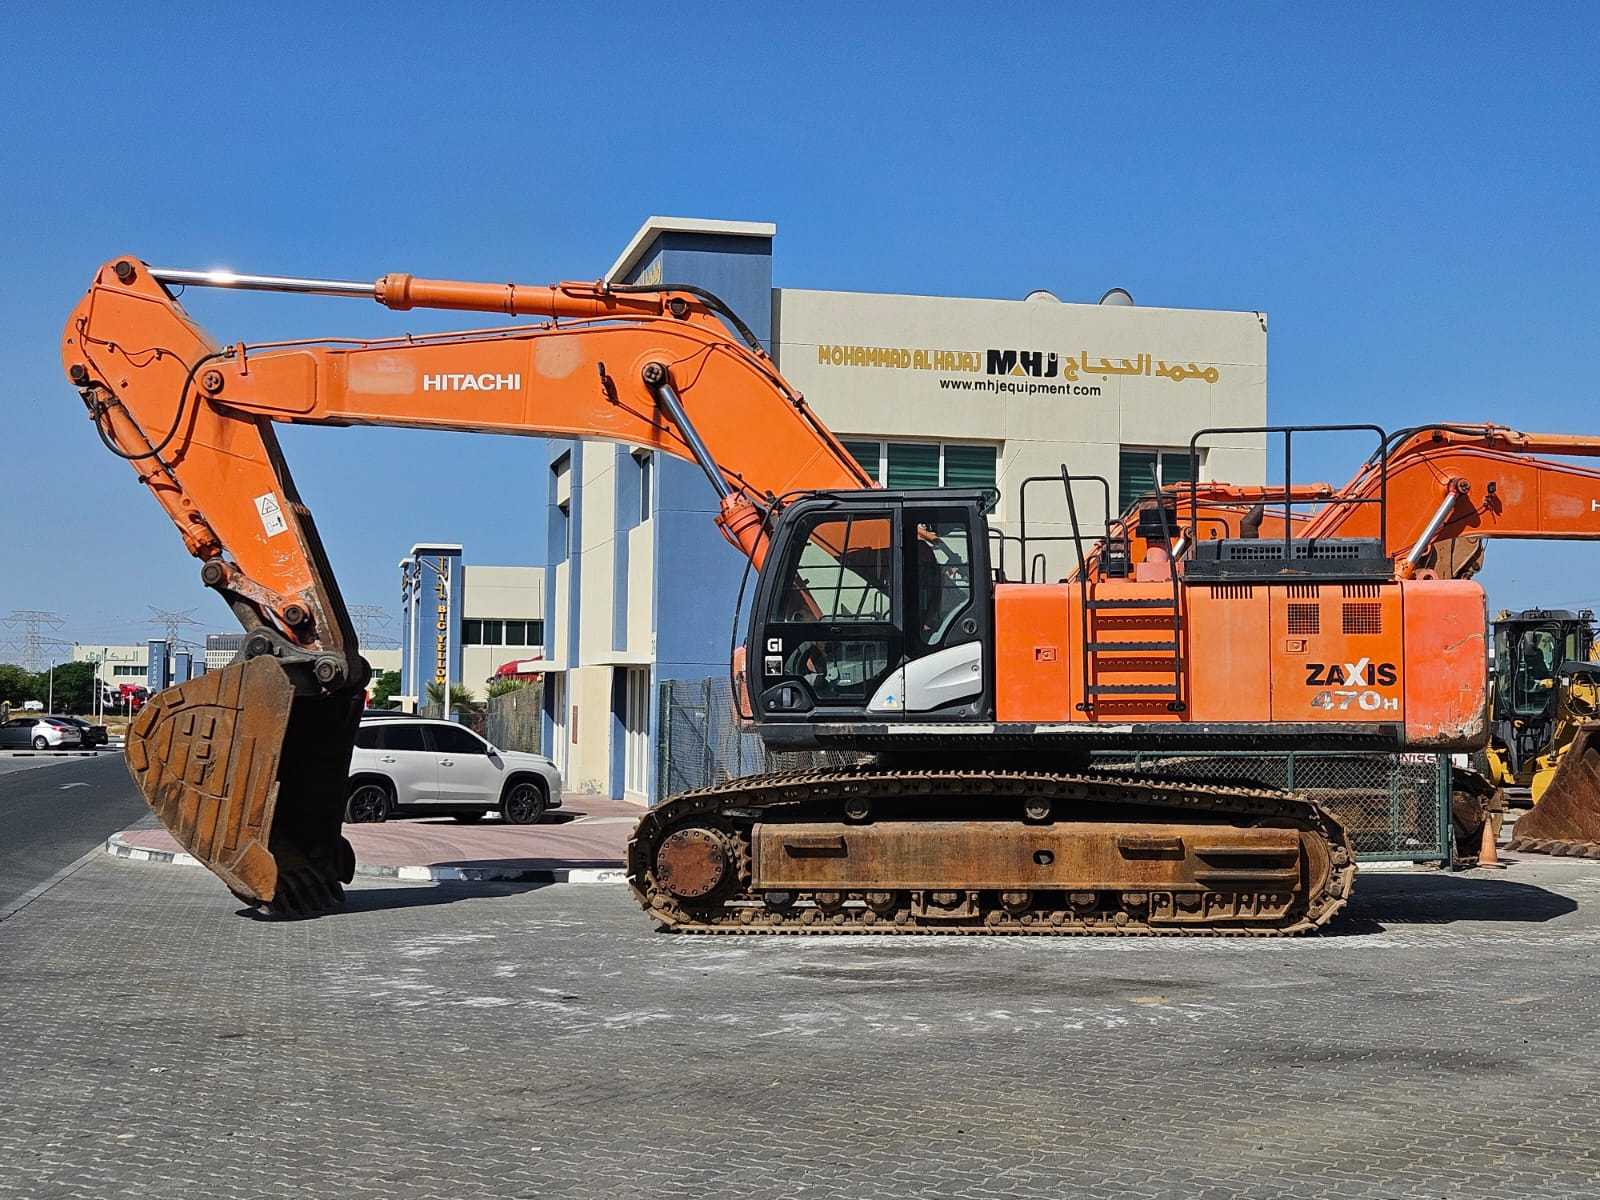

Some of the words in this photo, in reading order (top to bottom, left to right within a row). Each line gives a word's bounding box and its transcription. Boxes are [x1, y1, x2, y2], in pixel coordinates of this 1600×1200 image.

[818, 345, 912, 369] MOHAMMAD
[913, 350, 932, 370] AL
[933, 351, 982, 373] HAJAJ
[423, 373, 521, 391] HITACHI
[1155, 361, 1219, 384] محمد
[1306, 657, 1397, 686] ZAXIS
